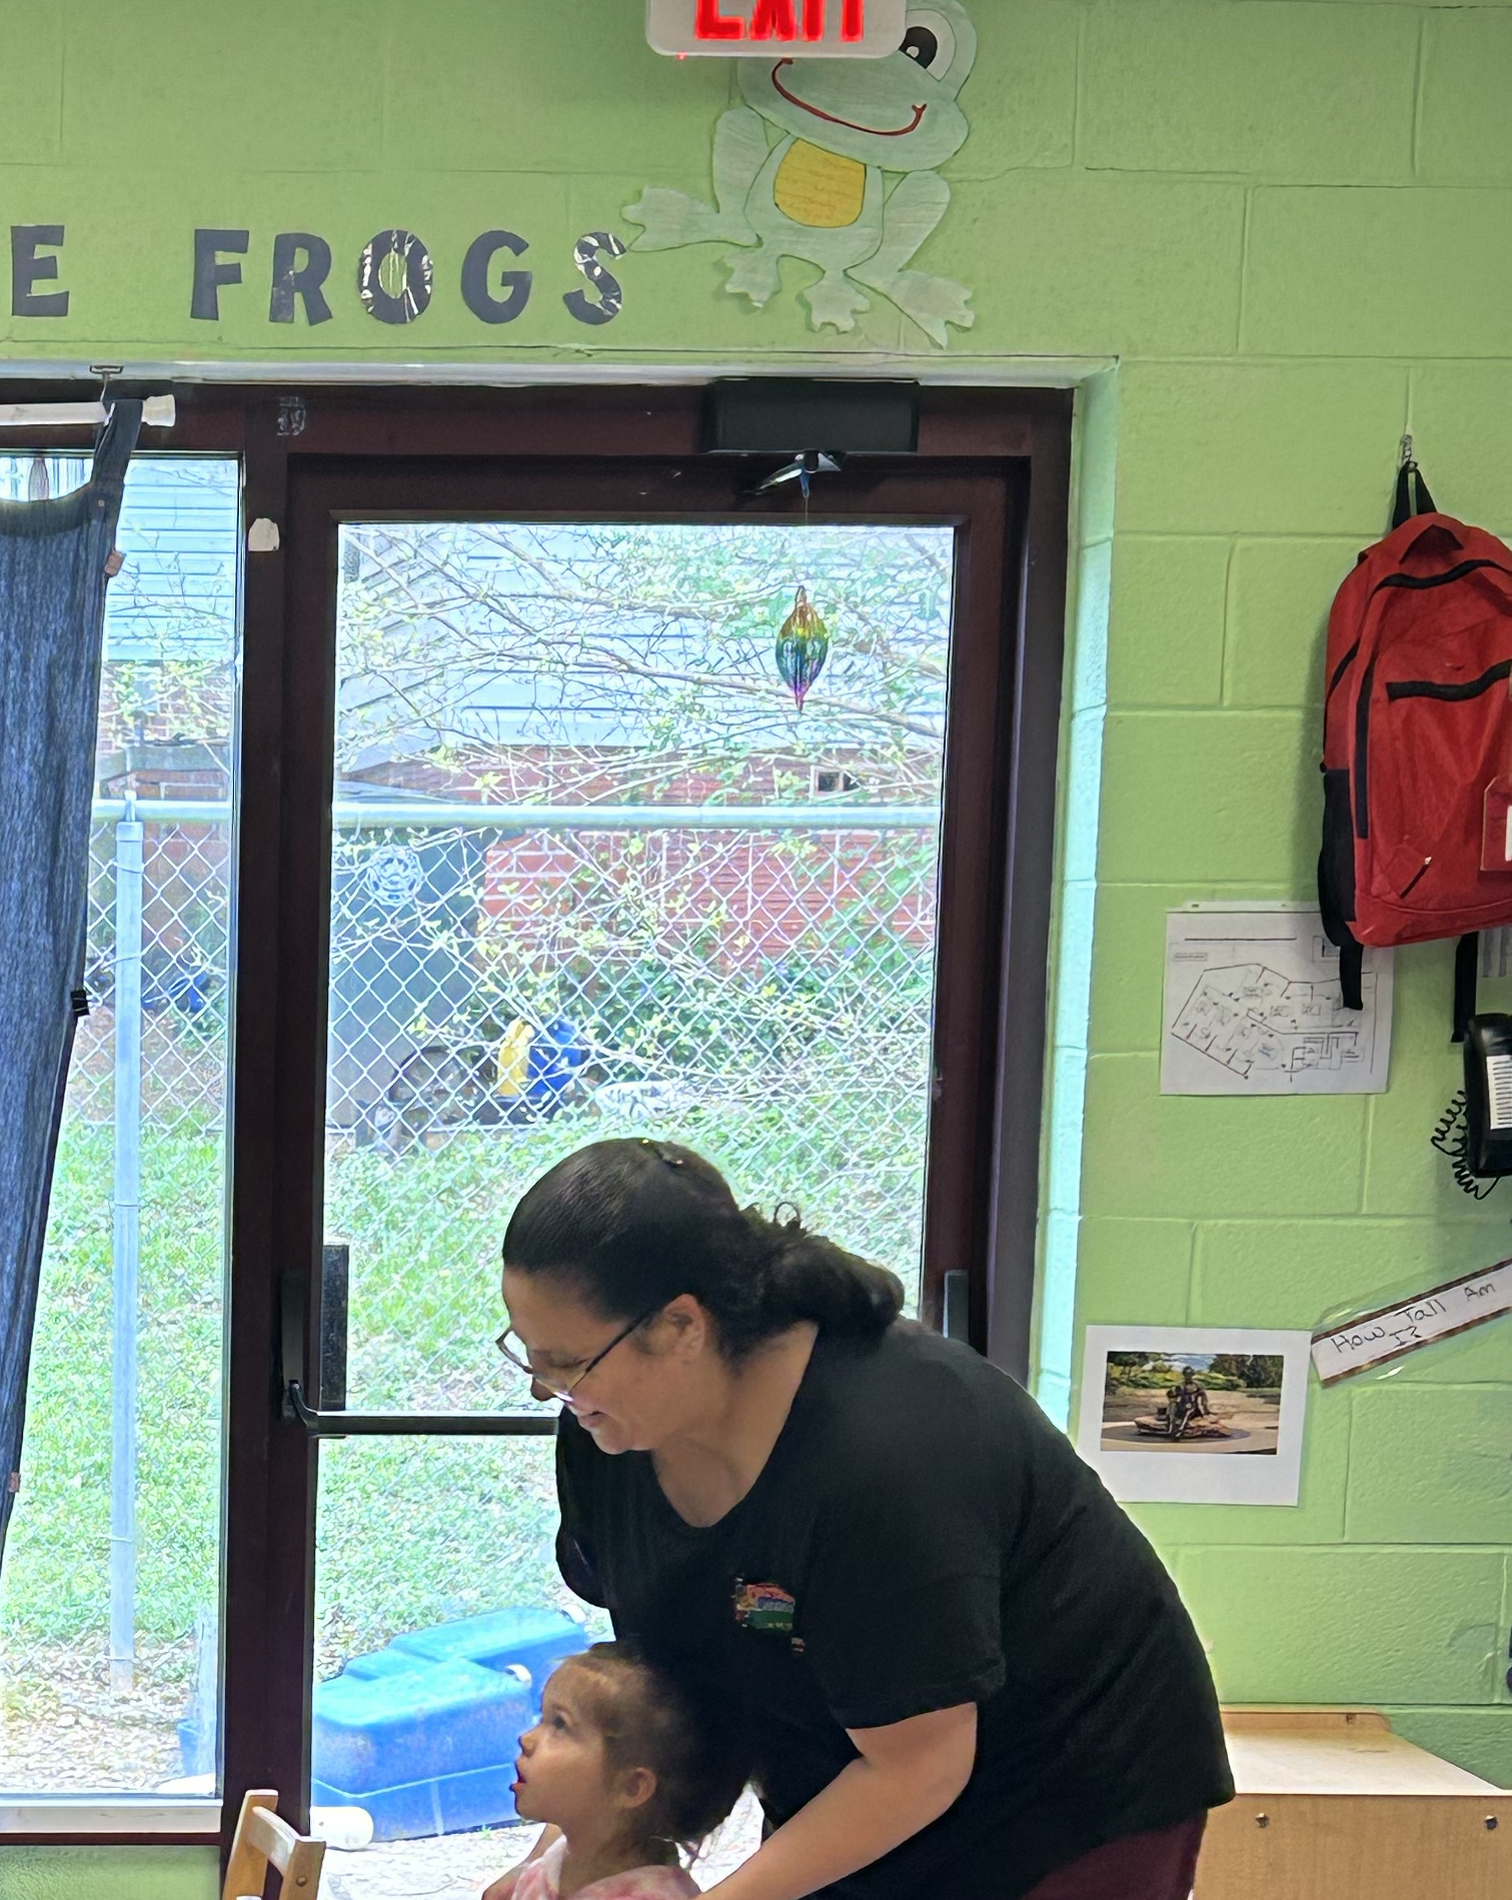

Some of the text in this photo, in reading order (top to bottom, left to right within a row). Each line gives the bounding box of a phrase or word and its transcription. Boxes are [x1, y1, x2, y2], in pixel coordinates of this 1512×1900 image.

[190, 228, 628, 326] FROGS
[1331, 1283, 1496, 1354] How Tall Am
